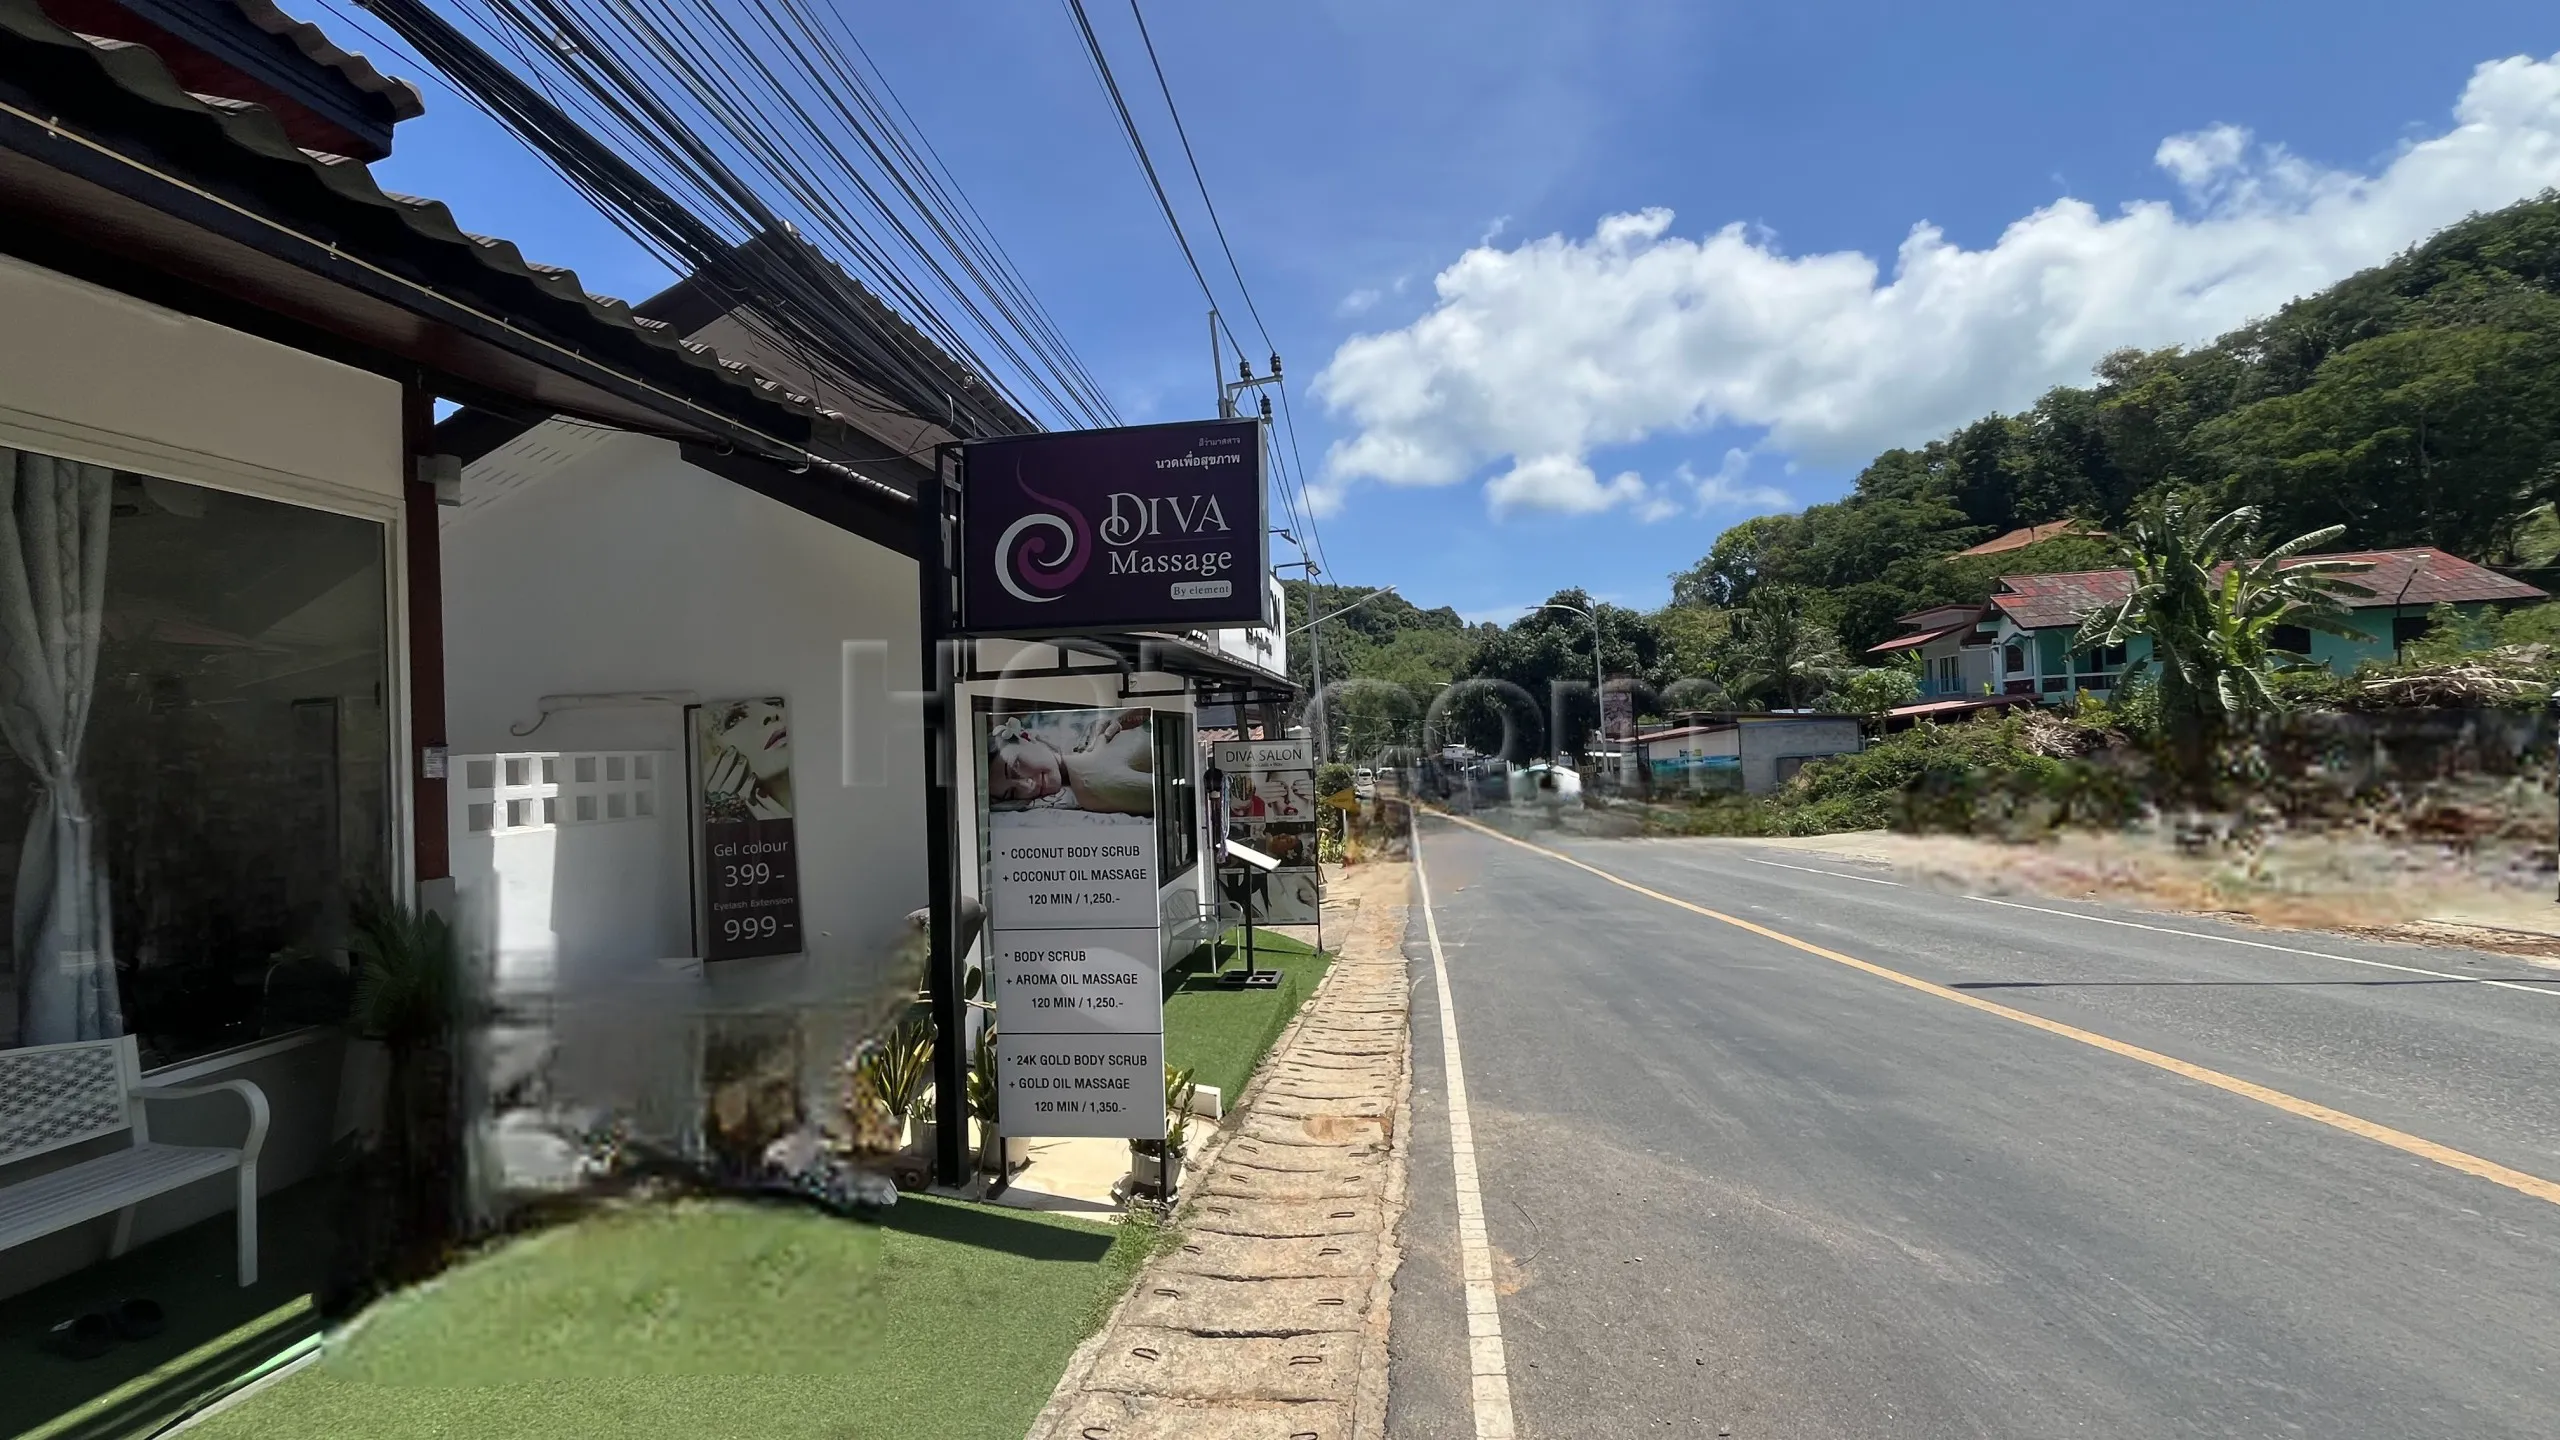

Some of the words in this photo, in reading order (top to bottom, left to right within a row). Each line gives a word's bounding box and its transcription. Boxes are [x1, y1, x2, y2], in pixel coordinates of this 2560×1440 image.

[1156, 451, 1240, 470] นวดเพื่อสุขภาพ
[1100, 492, 1231, 546] DIVA
[1108, 549, 1233, 578] Massage
[1173, 586, 1186, 597] By
[1189, 584, 1229, 595] element
[1226, 750, 1255, 762] DIVA
[1260, 749, 1302, 761] SALON
[714, 842, 737, 857] Gel
[742, 839, 789, 855] colour
[1011, 848, 1064, 859] COCONUT
[1067, 847, 1098, 858] BODY
[1101, 846, 1140, 857] SCRUB
[724, 863, 770, 888] 399
[1013, 870, 1066, 882] COCONUT
[1070, 870, 1088, 881] OIL
[1091, 869, 1147, 880] MASSAGE
[750, 897, 794, 908] Extension
[1028, 894, 1047, 904] 120
[1050, 894, 1072, 904] MIN
[1083, 893, 1120, 905] 1,250.-
[723, 915, 777, 941] 999
[1014, 952, 1044, 962] BODY
[1048, 951, 1086, 961] SCRUB
[1016, 974, 1057, 985] AROMA
[1061, 974, 1079, 984] OIL
[1082, 974, 1138, 985] MASSAGE
[1032, 998, 1050, 1008] 120
[1053, 998, 1075, 1008] MIN
[1087, 997, 1123, 1009] 1,250.-
[1016, 1055, 1036, 1066] 24K
[1040, 1055, 1070, 1066] GOLD
[1074, 1055, 1104, 1065] BODY
[1108, 1054, 1148, 1066] SCRUB
[1019, 1078, 1049, 1089] GOLD
[1053, 1078, 1071, 1088] OIL
[1075, 1078, 1130, 1089] MASSAGE
[1035, 1101, 1053, 1112] 120
[1057, 1101, 1079, 1112] MIN
[1090, 1101, 1126, 1113] 1,350.-
